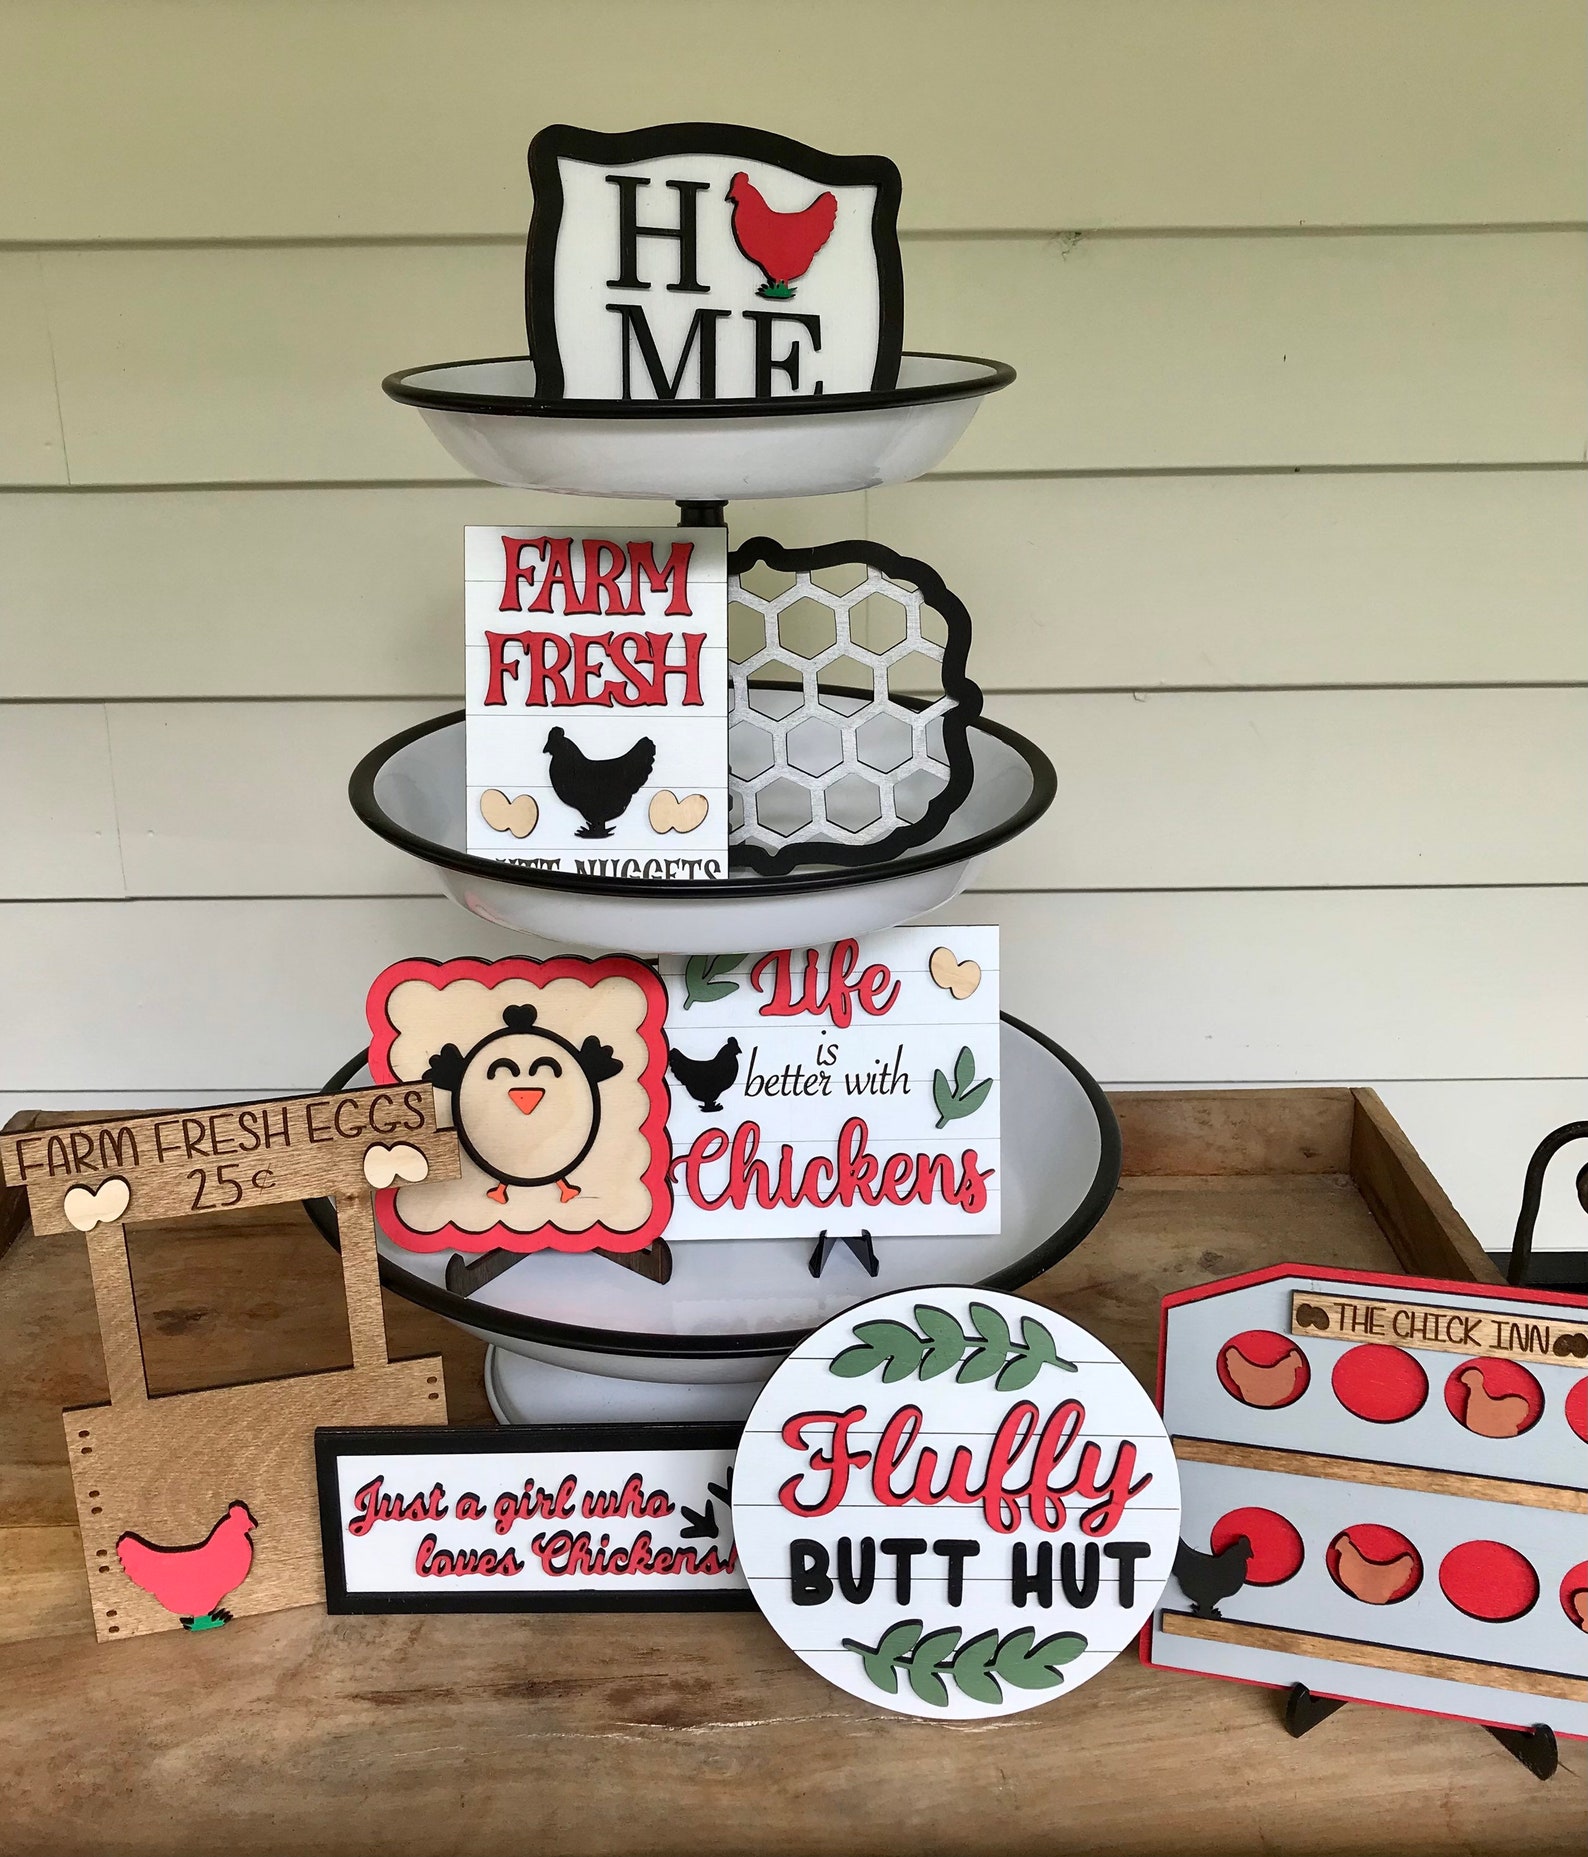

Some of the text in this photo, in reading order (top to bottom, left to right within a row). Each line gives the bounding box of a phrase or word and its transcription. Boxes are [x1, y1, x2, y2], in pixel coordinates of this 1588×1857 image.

[605, 303, 823, 400] ME
[499, 536, 694, 617] FARM
[484, 631, 707, 707] FRESH
[750, 937, 901, 1028] Life
[744, 1044, 911, 1097] better with
[816, 1030, 839, 1066] is
[16, 1090, 425, 1181] FARM FRESH EGGS
[669, 1117, 995, 1214] Chickens
[186, 1162, 278, 1211] 25¢
[1334, 1302, 1550, 1354] THE CHICK INN
[348, 1472, 676, 1537] Just a girl who
[778, 1398, 1153, 1537] Fluffy
[415, 1532, 525, 1578] loves
[789, 1536, 1152, 1610] BUTT HUT
